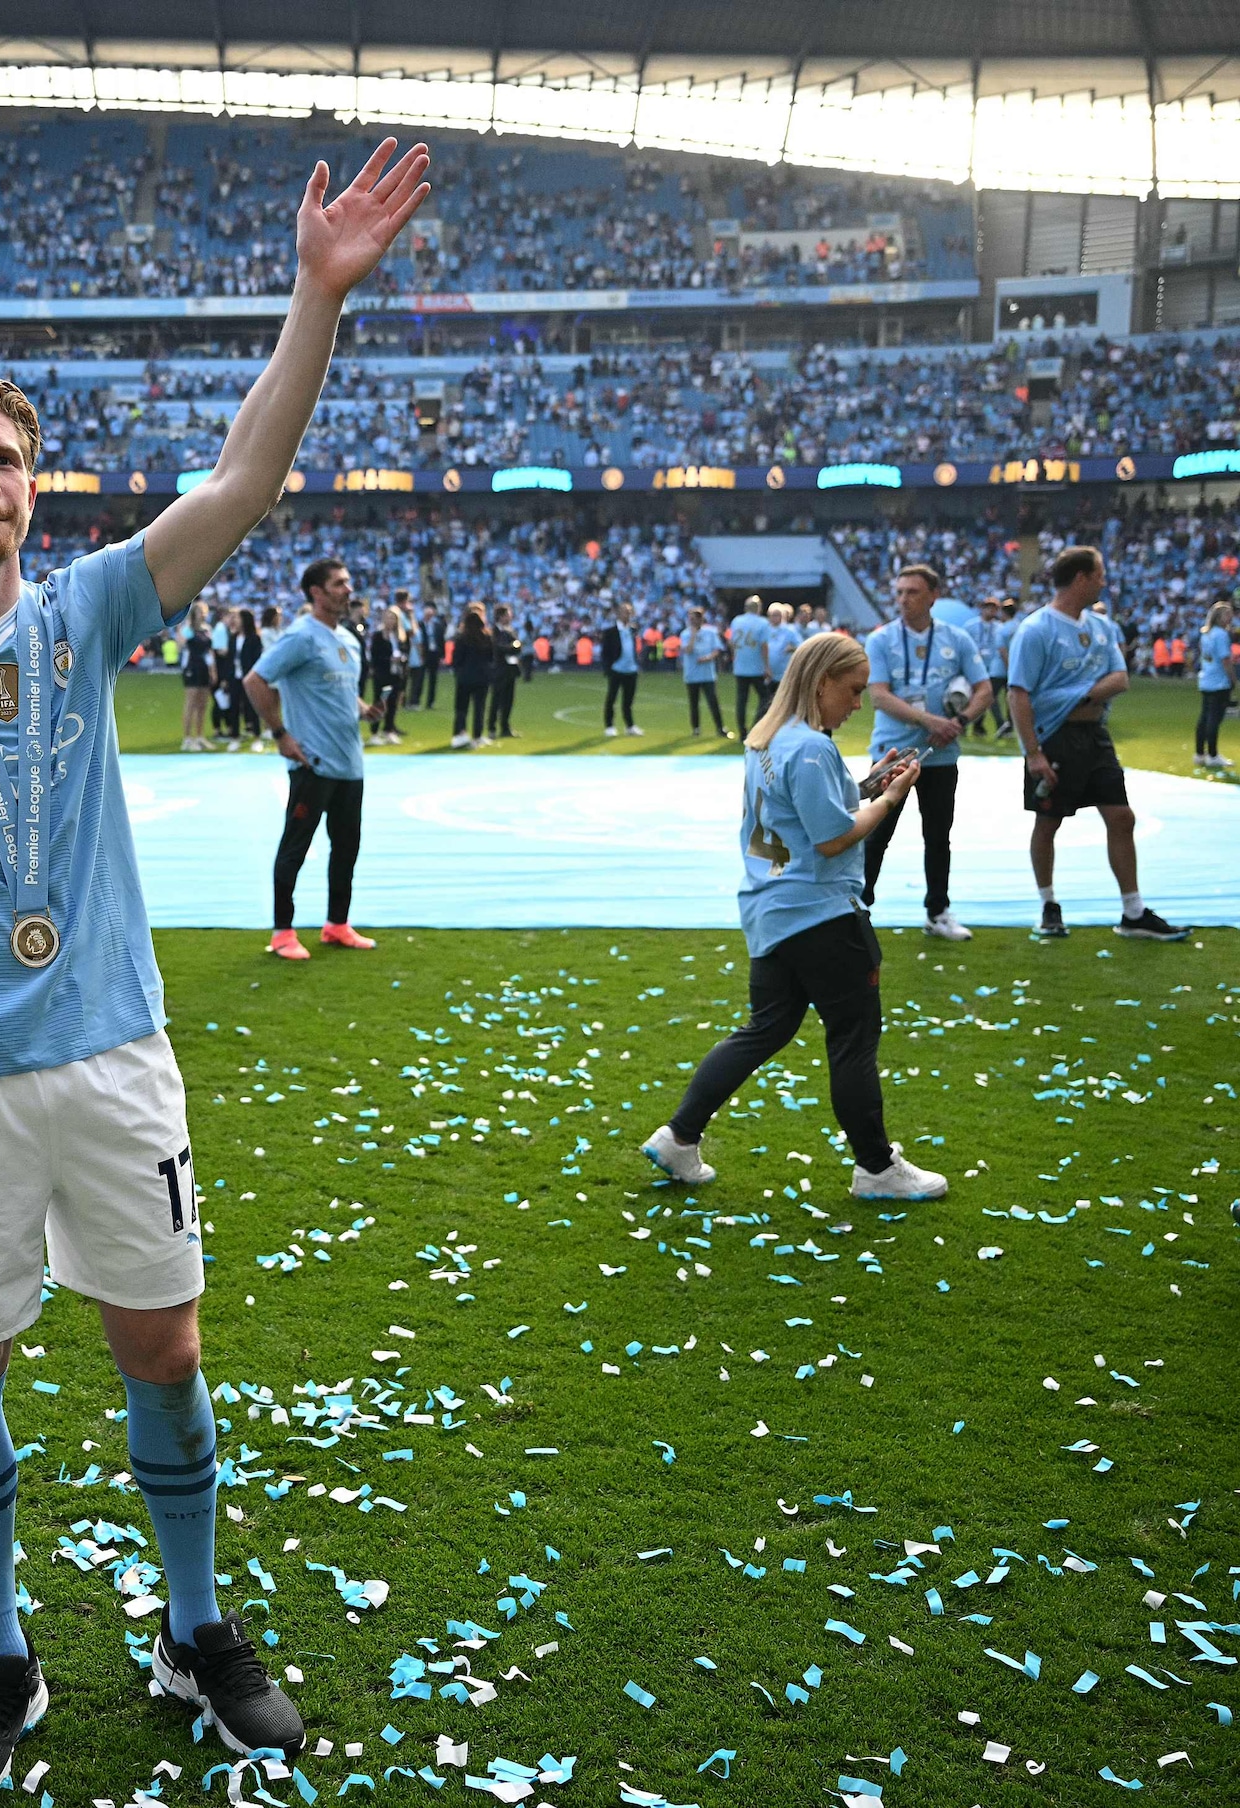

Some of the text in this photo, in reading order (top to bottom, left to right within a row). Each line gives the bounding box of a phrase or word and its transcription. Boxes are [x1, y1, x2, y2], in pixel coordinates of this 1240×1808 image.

[25, 625, 44, 885] Premier League Premier League
[2, 824, 18, 873] Leag
[743, 776, 790, 877] 4
[164, 1504, 213, 1519] CITY
